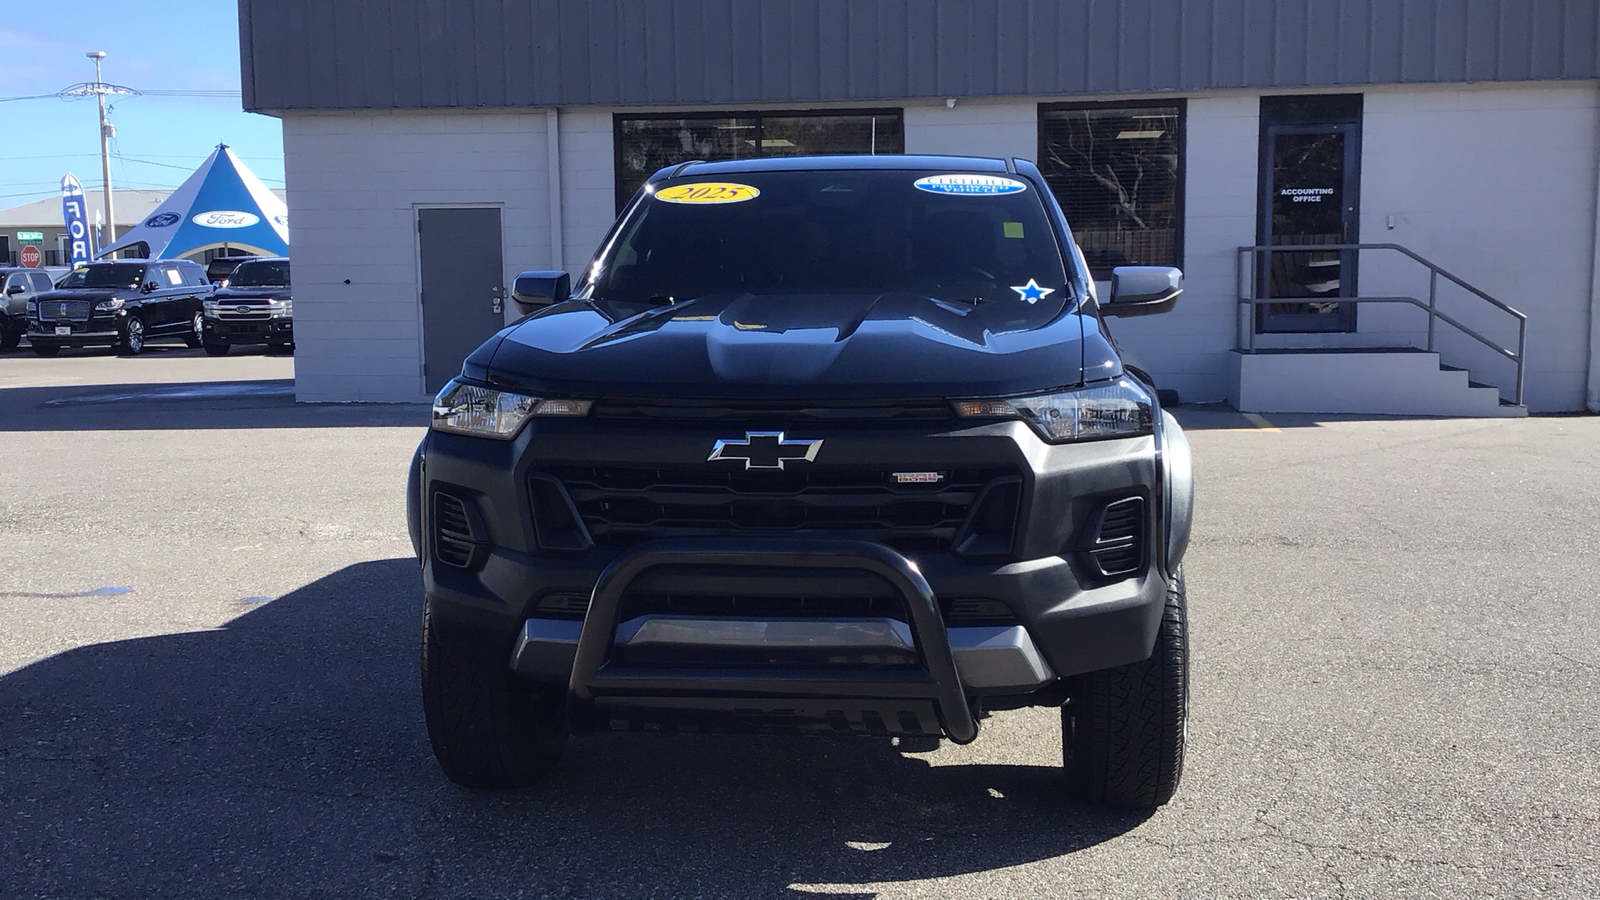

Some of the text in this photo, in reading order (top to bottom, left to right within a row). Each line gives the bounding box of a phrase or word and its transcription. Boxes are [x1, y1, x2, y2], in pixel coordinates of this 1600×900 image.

[927, 177, 1013, 186] CERTIFIED
[670, 186, 747, 199] 2025
[206, 213, 246, 225] Ford
[22, 252, 39, 262] STOP
